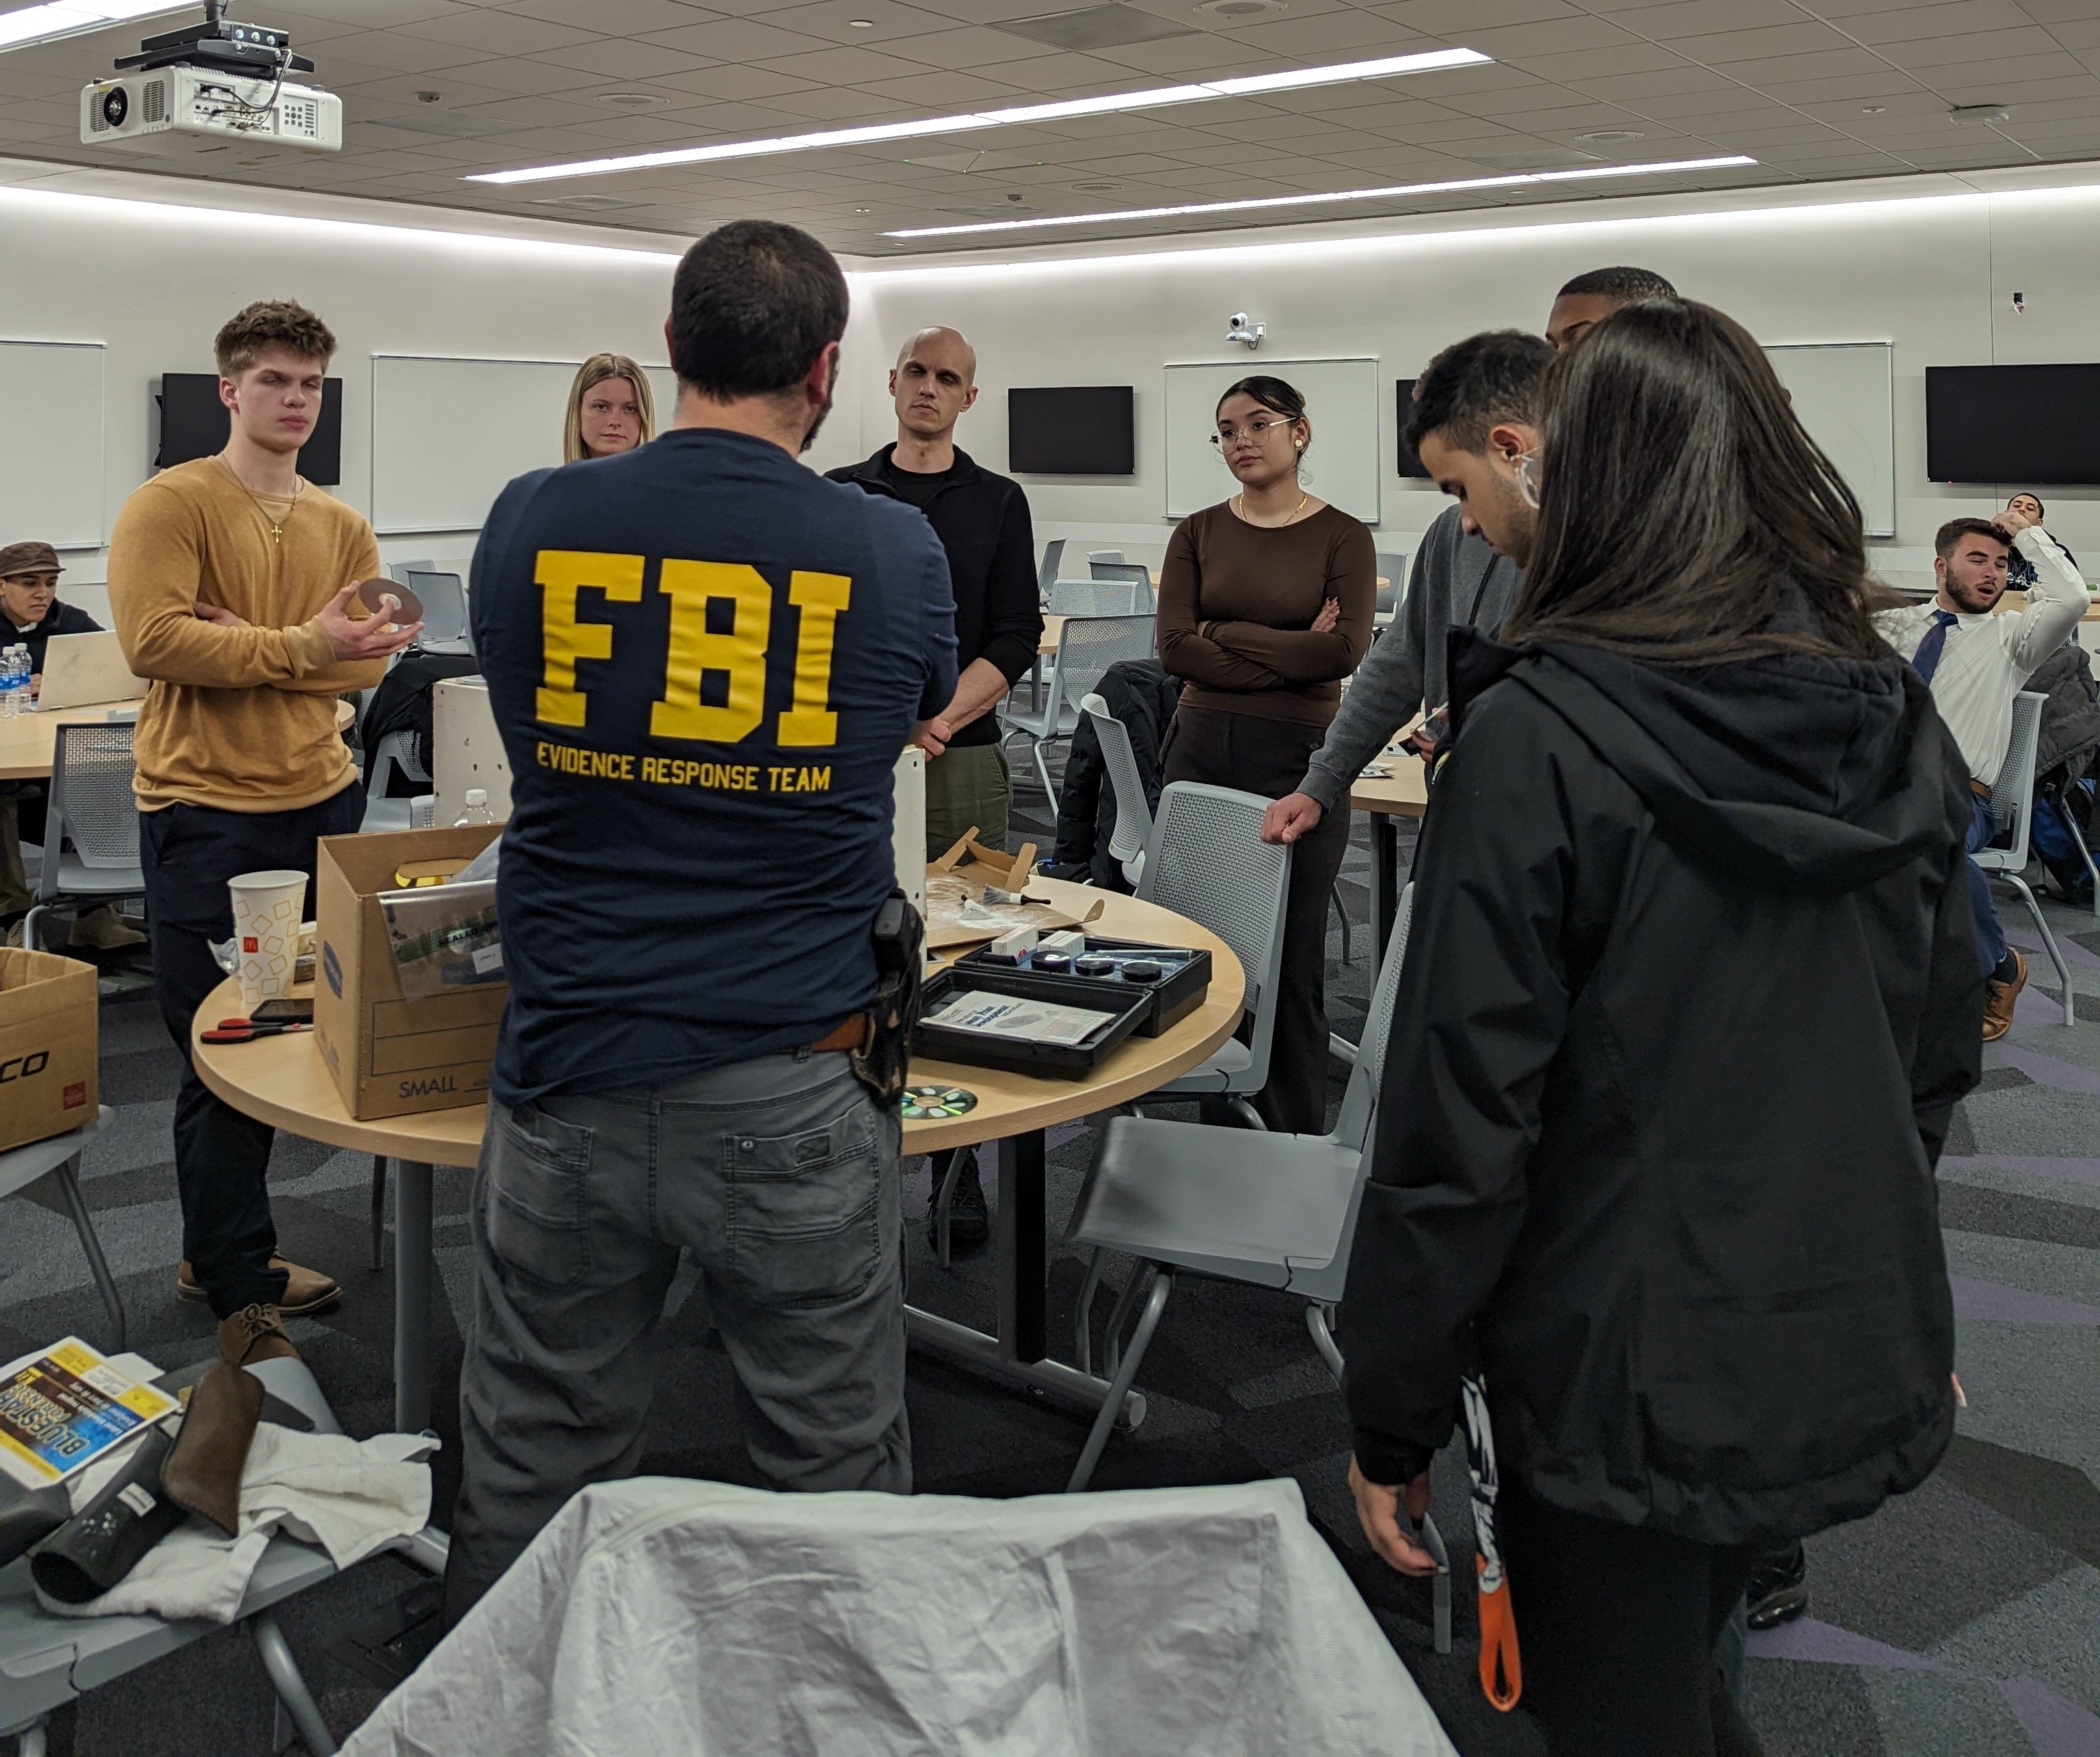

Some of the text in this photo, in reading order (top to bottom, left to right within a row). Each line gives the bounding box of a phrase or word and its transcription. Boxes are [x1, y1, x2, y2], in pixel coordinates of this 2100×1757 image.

[534, 550, 852, 747] FBI
[537, 741, 832, 792] EVIDENCE RESPONSE TEAM
[398, 1075, 457, 1098] SMALL
[0, 1389, 90, 1458] BLUESTAR
